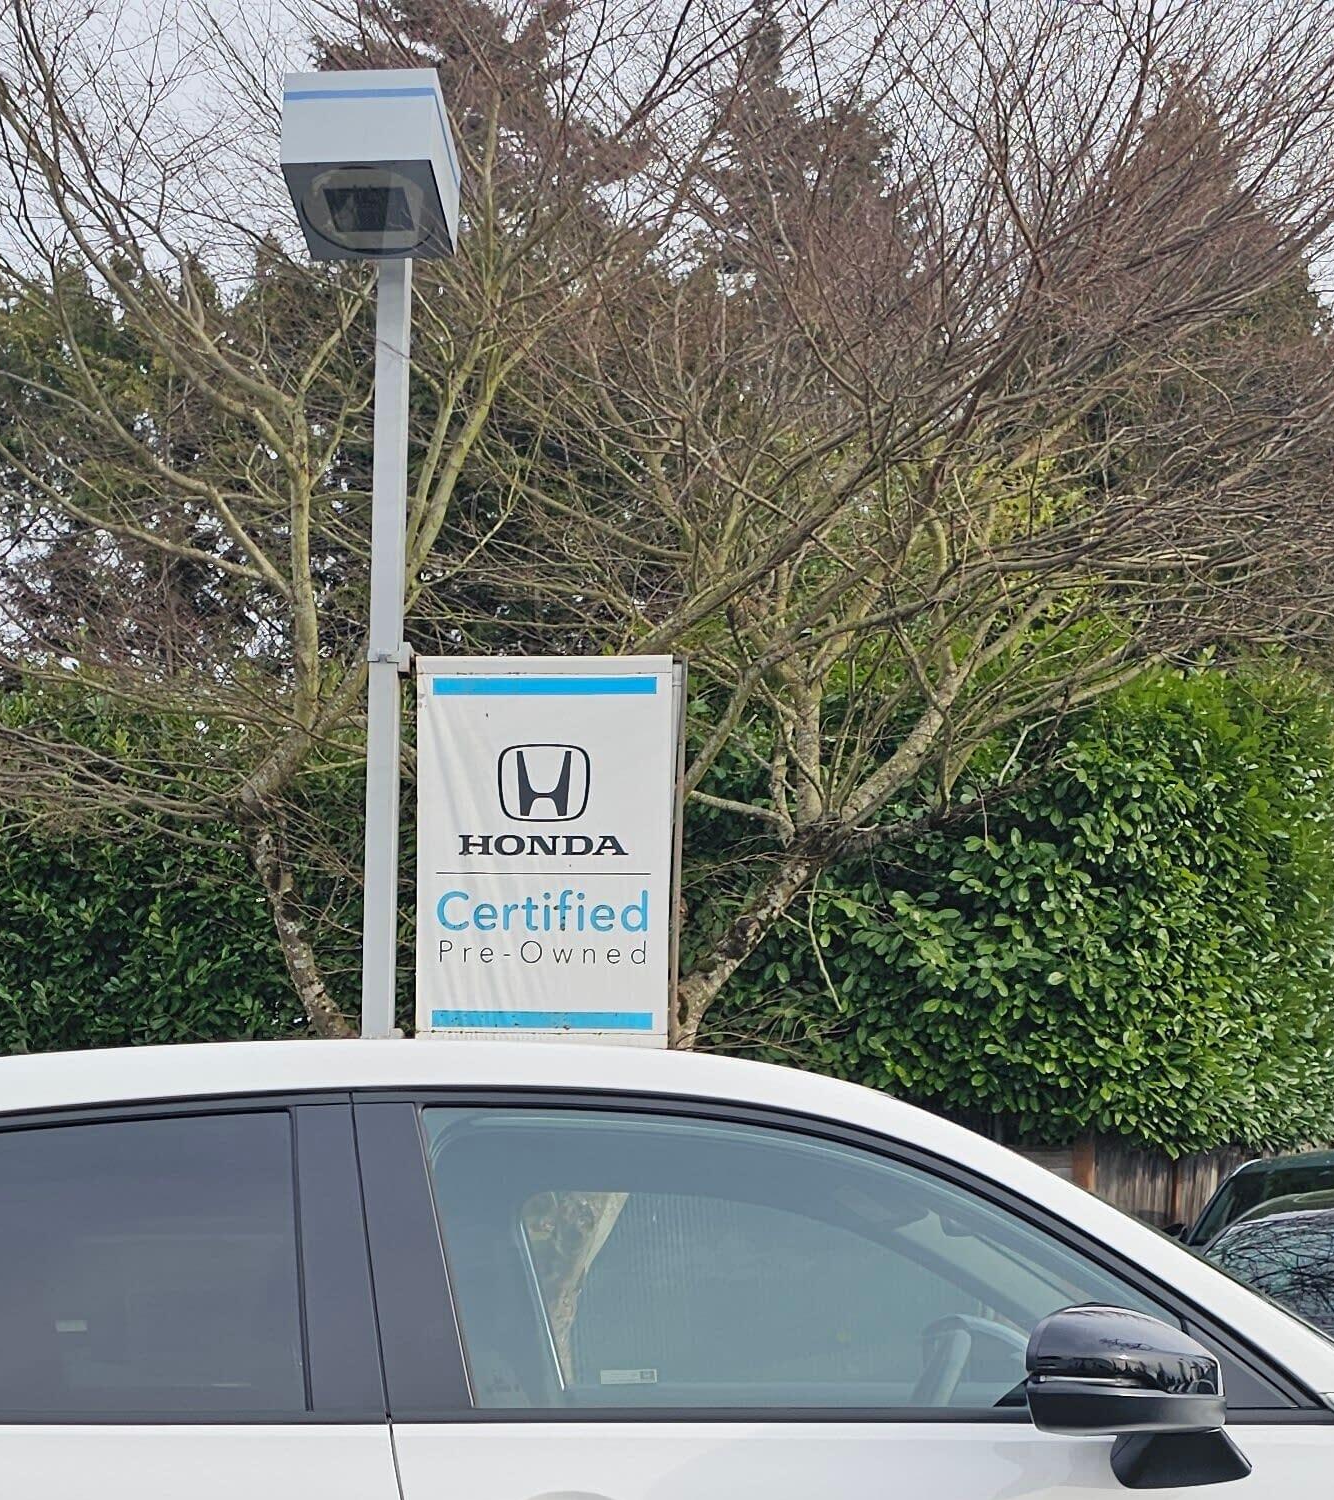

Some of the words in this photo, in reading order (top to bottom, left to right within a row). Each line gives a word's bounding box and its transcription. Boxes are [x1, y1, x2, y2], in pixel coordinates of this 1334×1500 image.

[458, 834, 629, 857] HONDA
[436, 889, 649, 933] Certified
[438, 940, 648, 965] Pre-Owned
